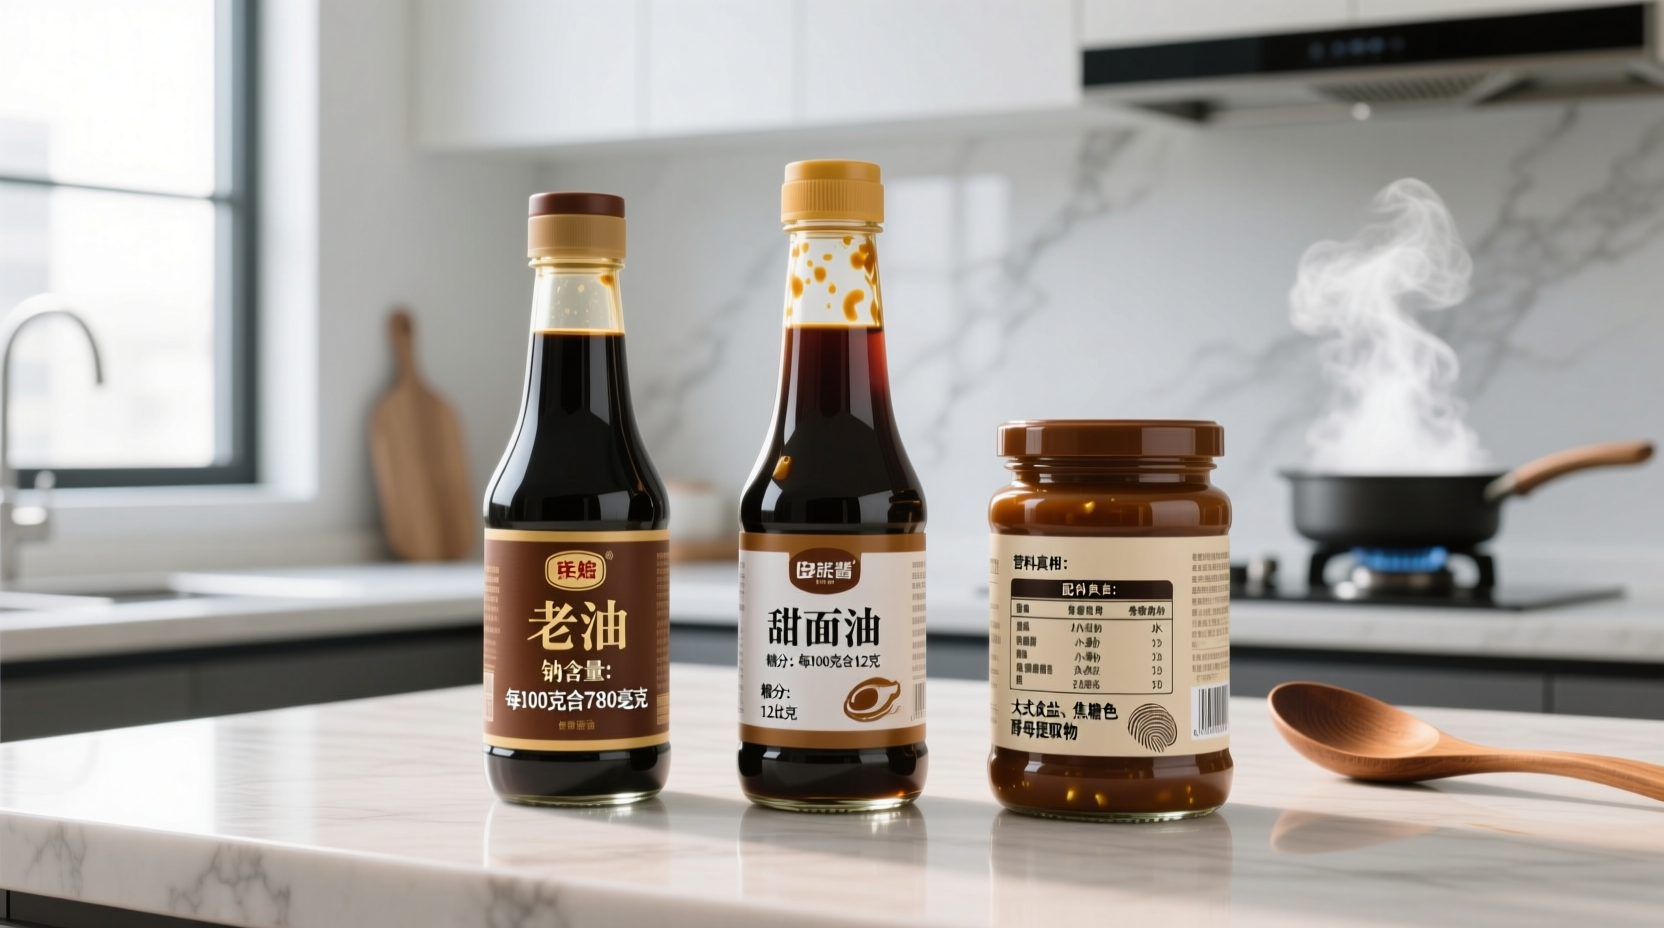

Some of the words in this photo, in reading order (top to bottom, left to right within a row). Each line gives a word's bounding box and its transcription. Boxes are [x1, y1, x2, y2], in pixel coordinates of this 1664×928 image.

[527, 599, 628, 651] 老油
[767, 606, 881, 648] 甜面油
